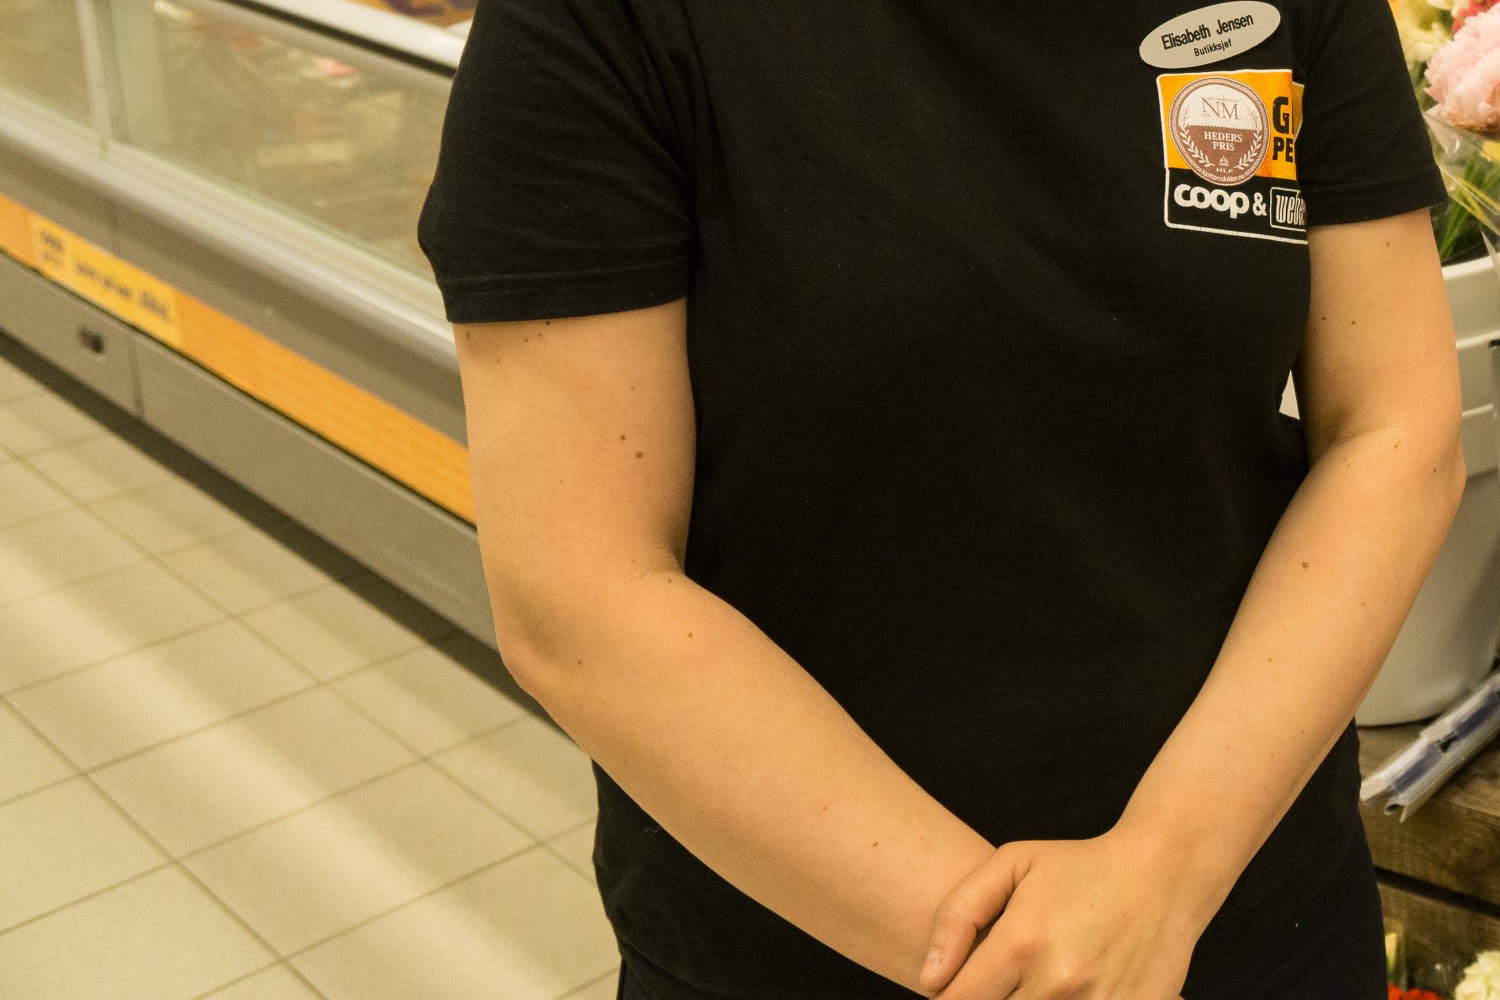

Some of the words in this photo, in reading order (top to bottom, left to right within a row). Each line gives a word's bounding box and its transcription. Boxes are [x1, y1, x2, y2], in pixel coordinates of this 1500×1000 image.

[1161, 24, 1212, 50] Elisabeth
[1216, 14, 1254, 35] Jensen
[1193, 38, 1232, 57] Butikksjef
[1201, 97, 1241, 121] NM
[1203, 130, 1243, 143] HEDERS
[1212, 140, 1236, 152] PRIS
[1174, 183, 1250, 219] coop
[1252, 192, 1267, 216] &
